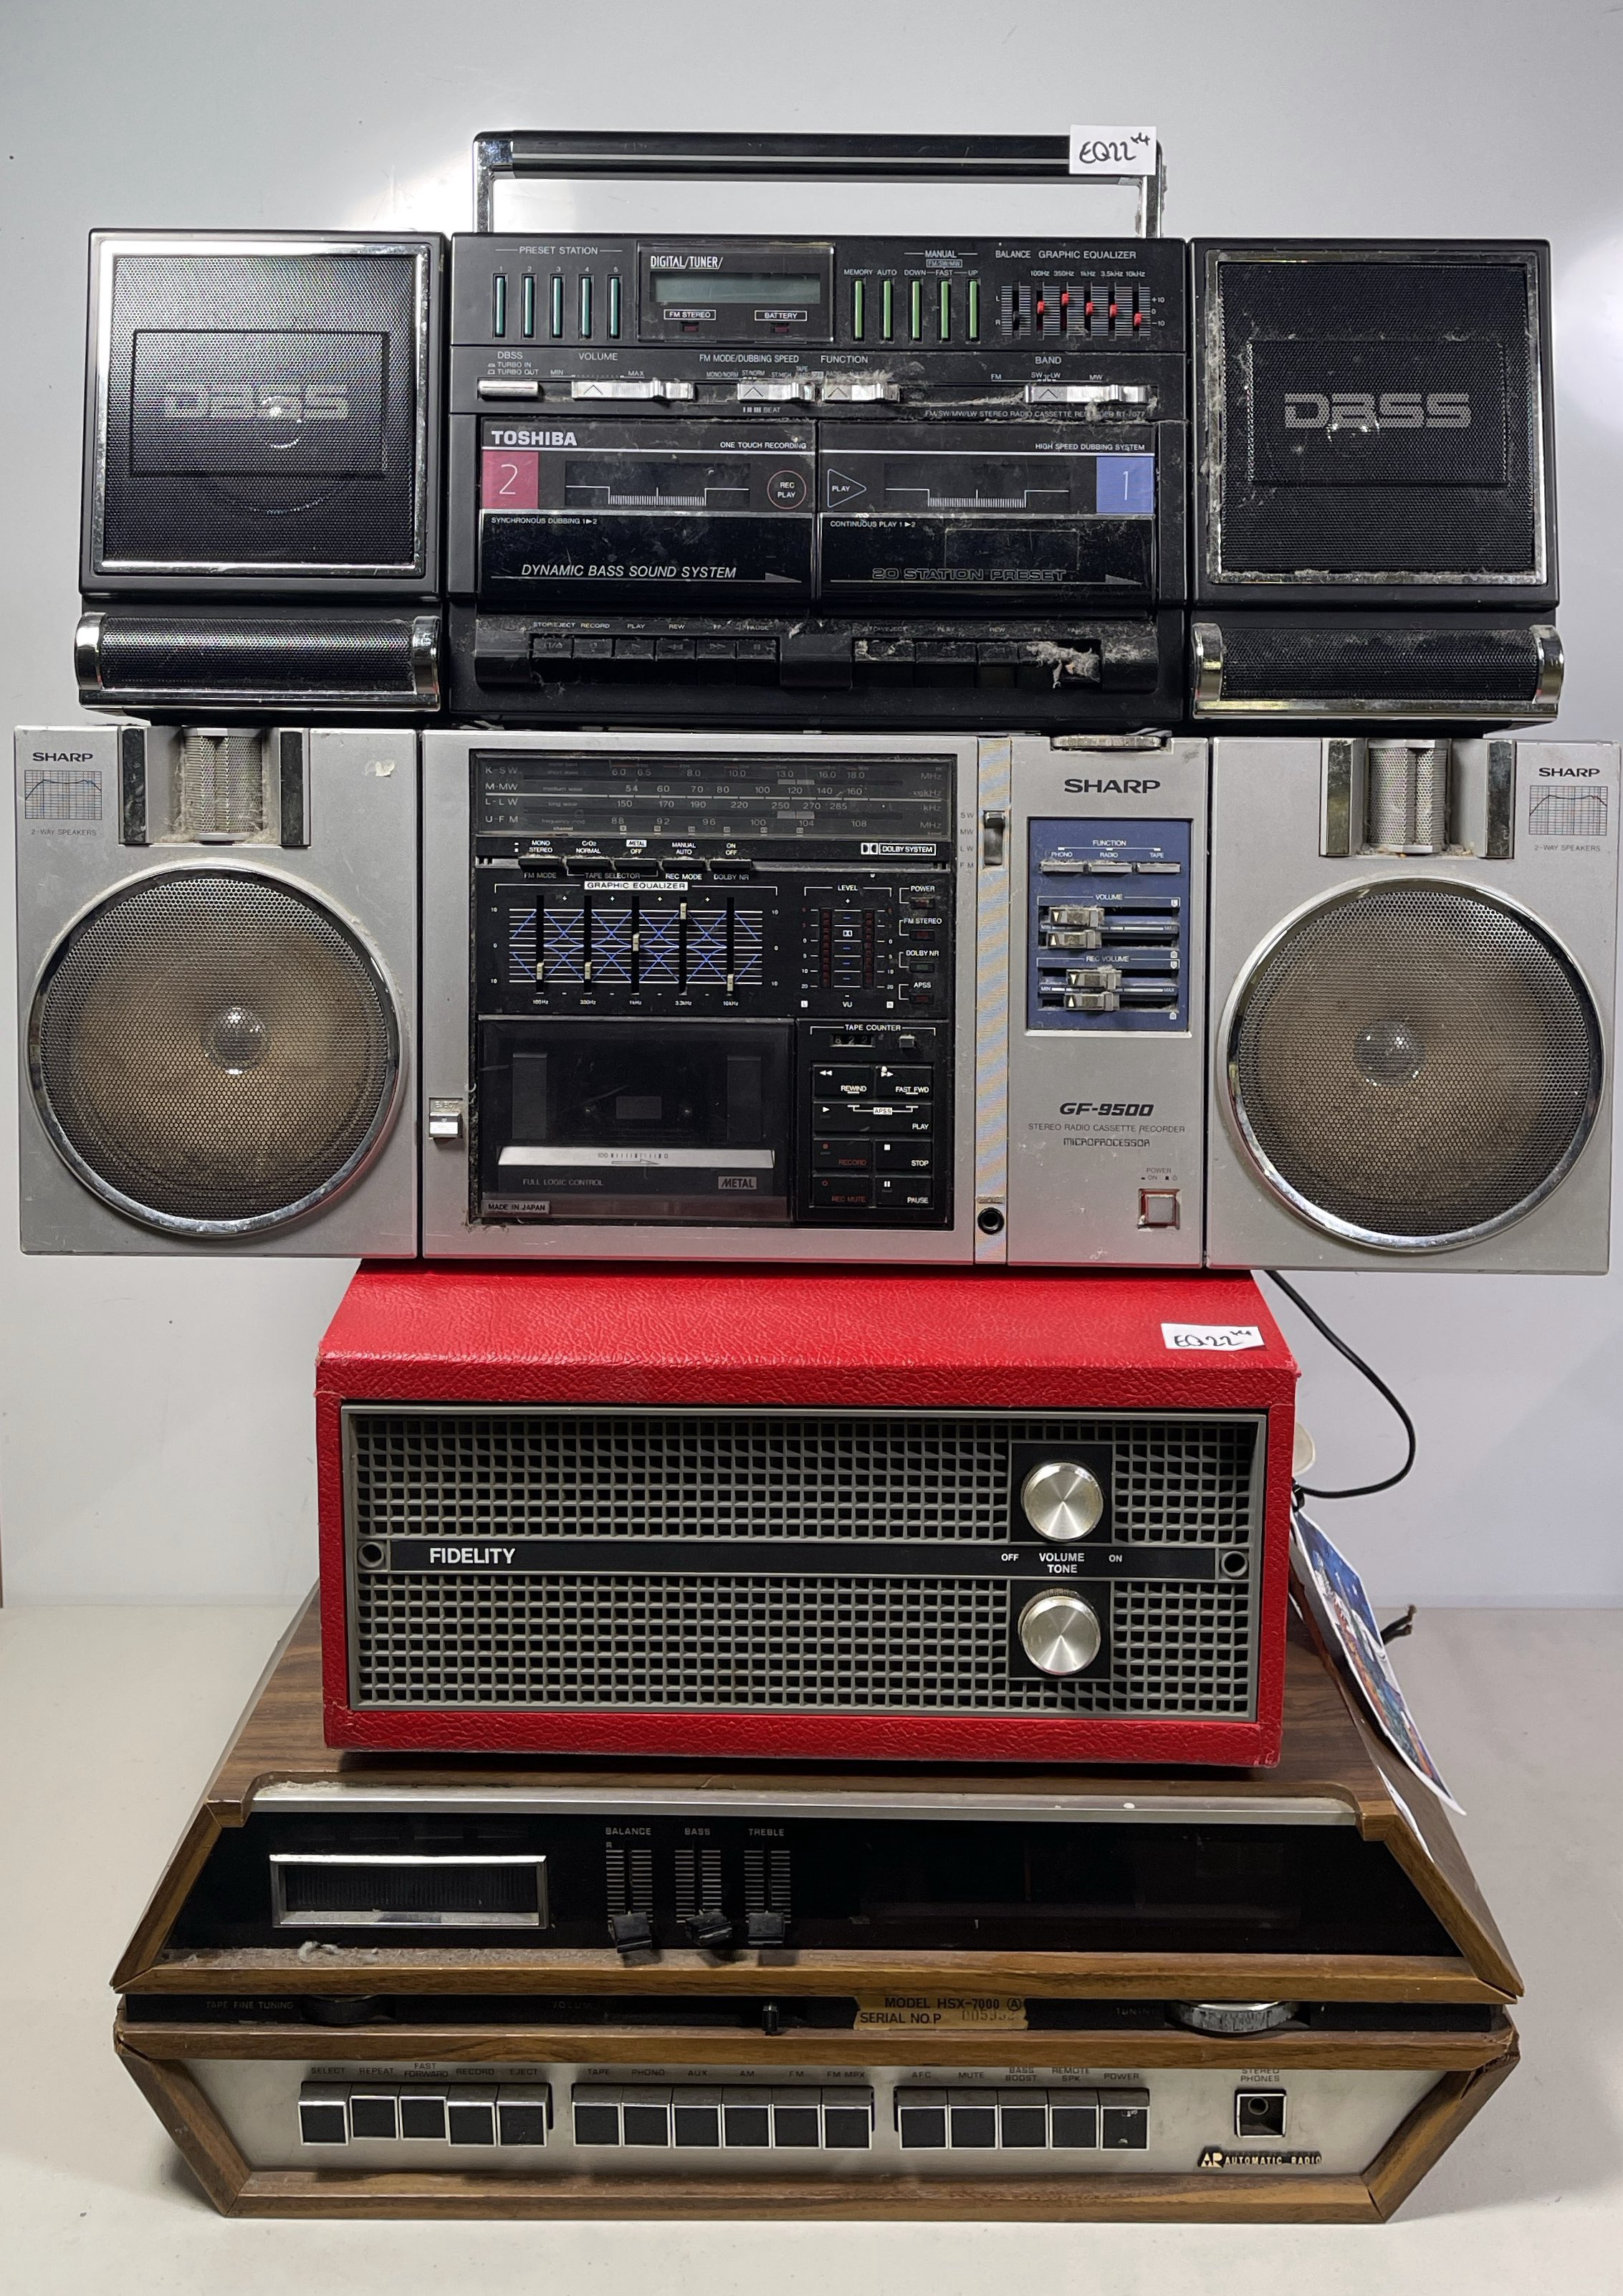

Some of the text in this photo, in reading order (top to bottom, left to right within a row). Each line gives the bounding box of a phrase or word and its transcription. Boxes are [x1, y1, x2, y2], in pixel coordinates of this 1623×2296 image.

[492, 431, 577, 446] TOSHIBA
[499, 464, 519, 495] 2
[1123, 472, 1129, 500] 1
[522, 565, 736, 578] DYNAMIC BASS SOUND SYSTEM
[872, 568, 1066, 581] 20 STATION PRESET
[33, 752, 93, 762] SHARP
[1539, 767, 1600, 777] SHARP
[1064, 779, 1161, 793] SHARP
[1060, 1103, 1154, 1116] GF-9500
[1063, 1138, 1150, 1147] MICROPROCESSOR
[722, 1178, 754, 1187] METAL
[430, 1548, 515, 1564] FIDELITY
[1039, 1553, 1085, 1561] VOLUME
[1047, 1564, 1077, 1573] TONE
[885, 1998, 999, 2009] MODEL HSX-7000
[1291, 2156, 1321, 2165] RADIO
